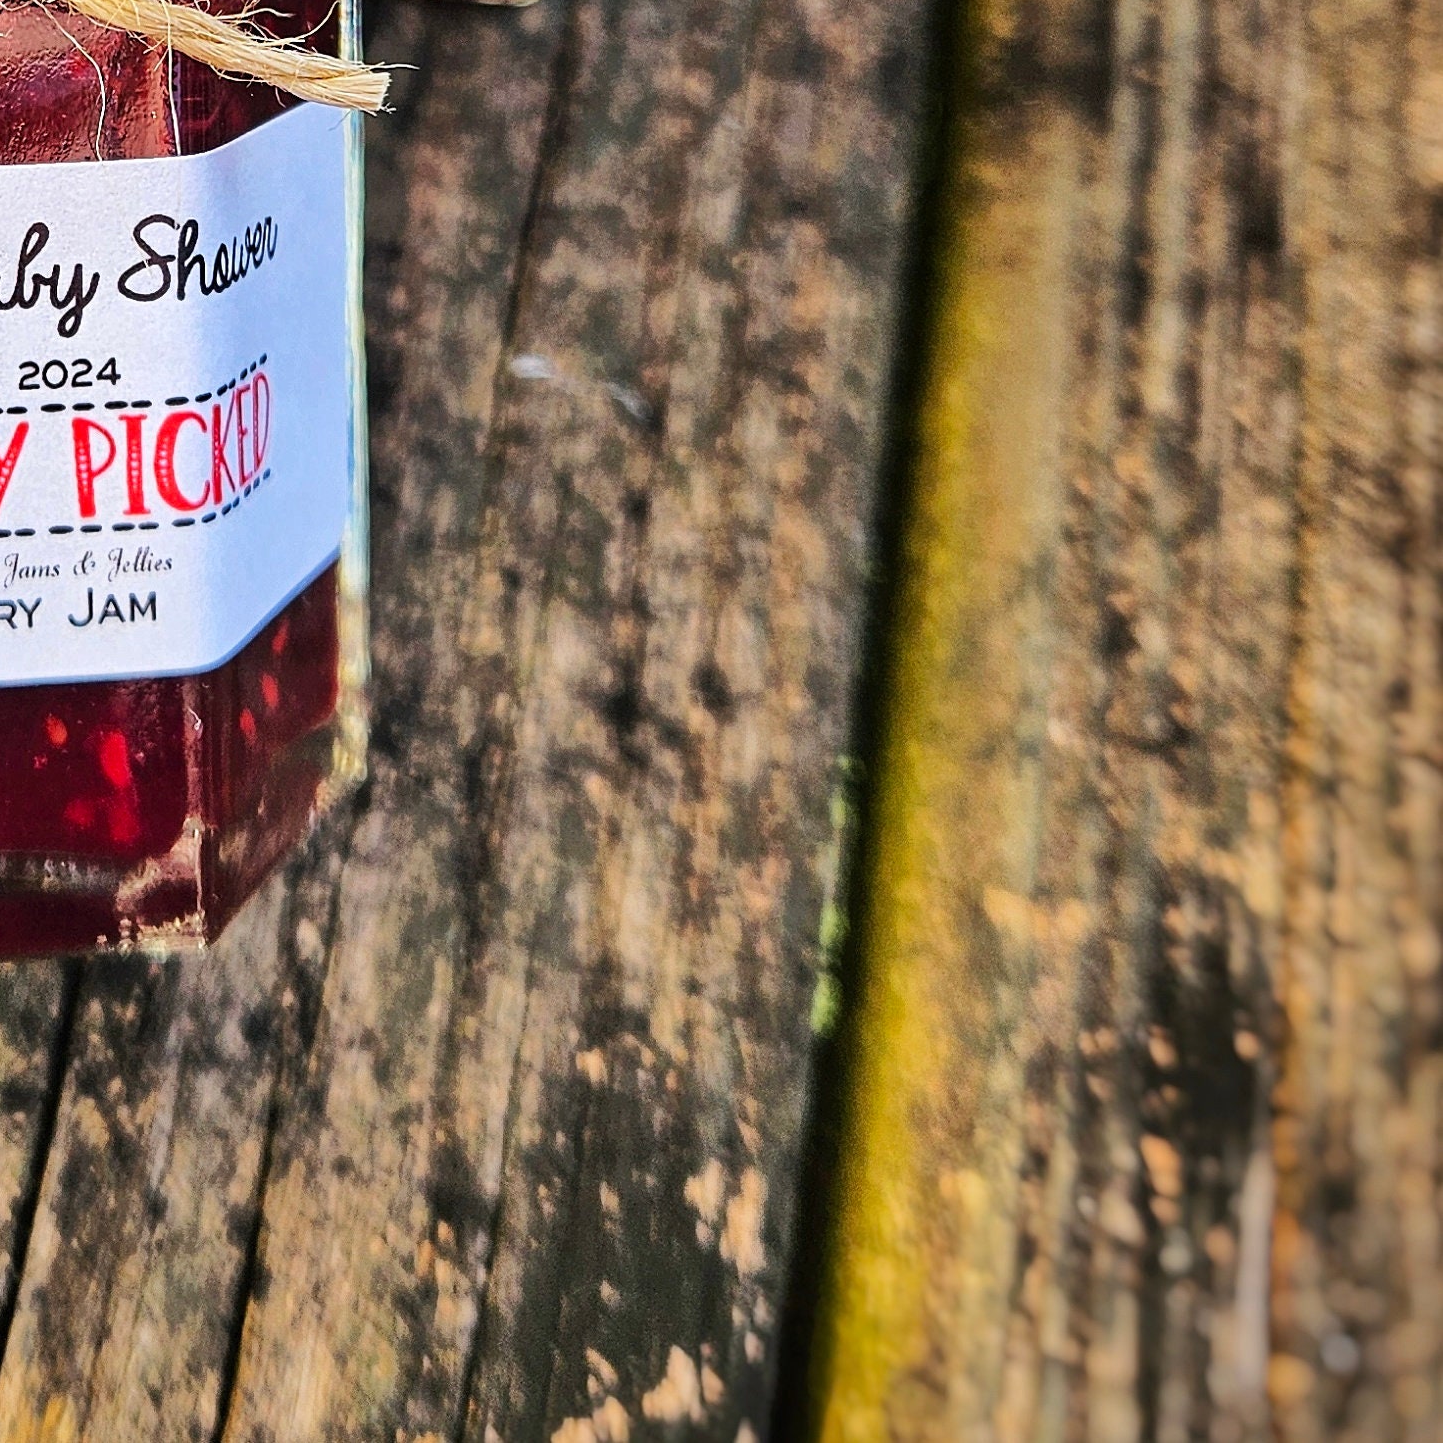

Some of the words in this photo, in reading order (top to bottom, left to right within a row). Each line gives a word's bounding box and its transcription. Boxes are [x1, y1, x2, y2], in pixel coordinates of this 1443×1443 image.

[117, 212, 279, 302] Shower
[18, 357, 122, 391] 2024
[70, 371, 271, 519] PICKED
[3, 552, 61, 589] Jams
[72, 550, 97, 577] &
[107, 545, 174, 583] Jellies
[67, 586, 157, 628] JAM
